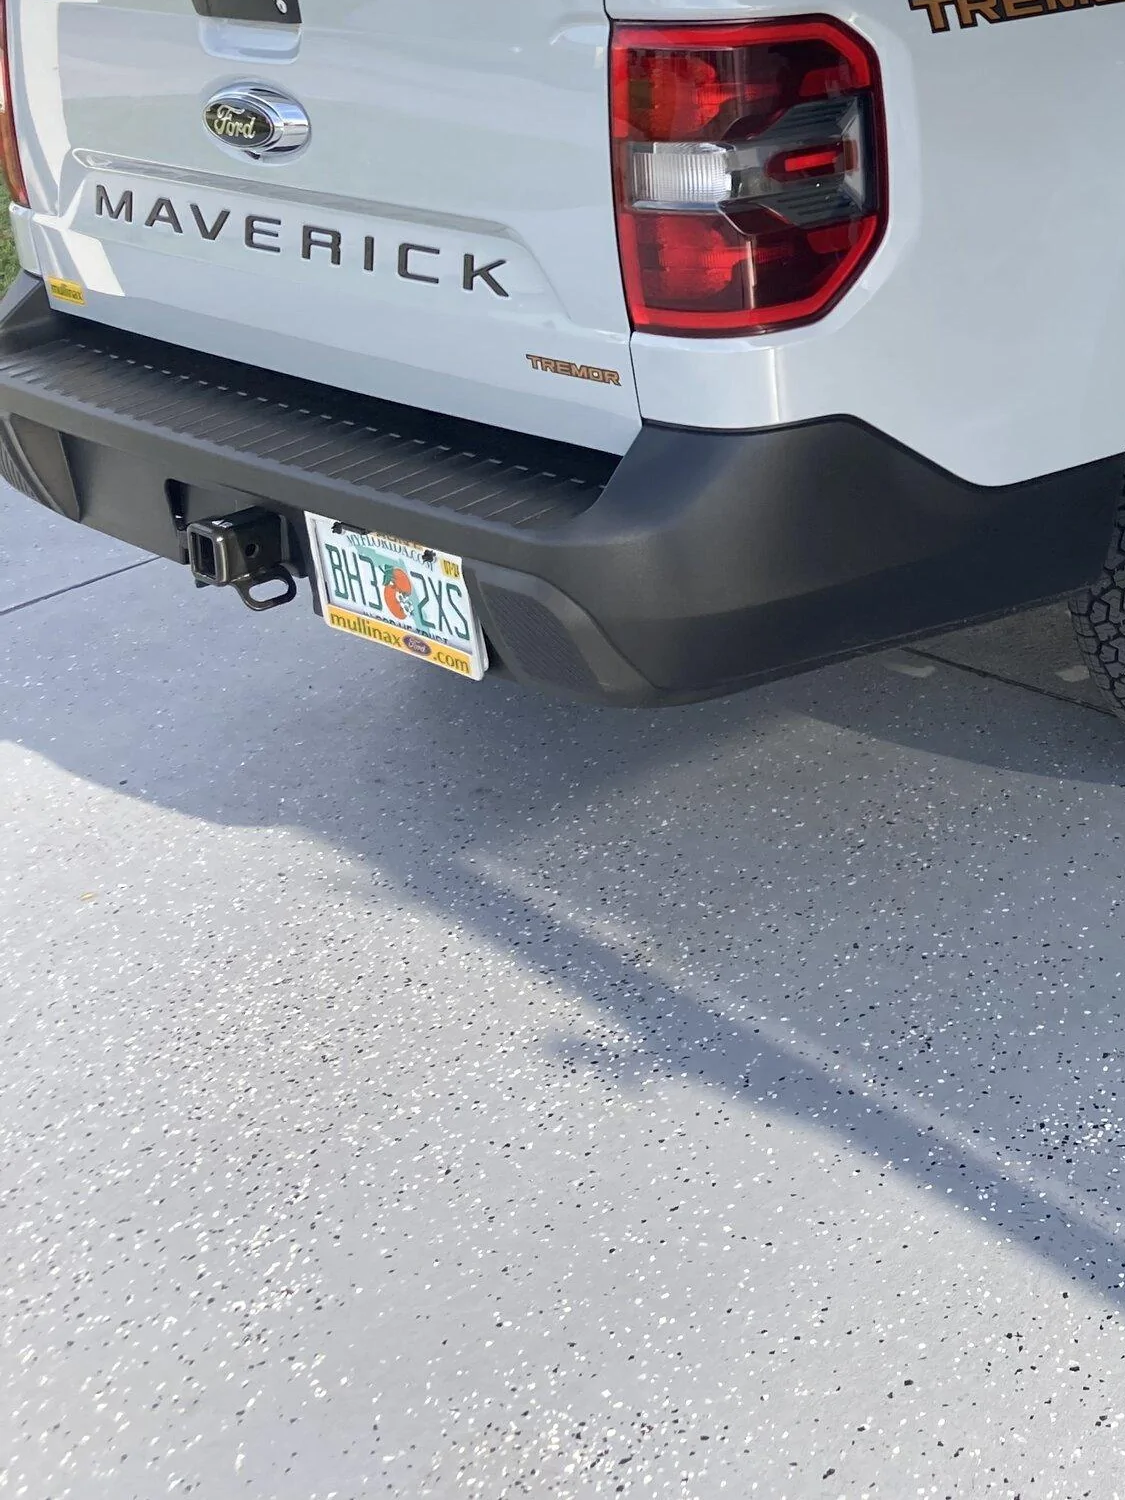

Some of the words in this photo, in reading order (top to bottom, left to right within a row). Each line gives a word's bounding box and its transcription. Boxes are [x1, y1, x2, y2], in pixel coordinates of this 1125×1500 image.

[213, 104, 257, 140] Ford
[95, 184, 510, 298] MAVERICK
[525, 353, 622, 387] TREMOR
[325, 543, 383, 611] BH3
[410, 571, 470, 641] 2XS
[330, 613, 402, 647] mullinax
